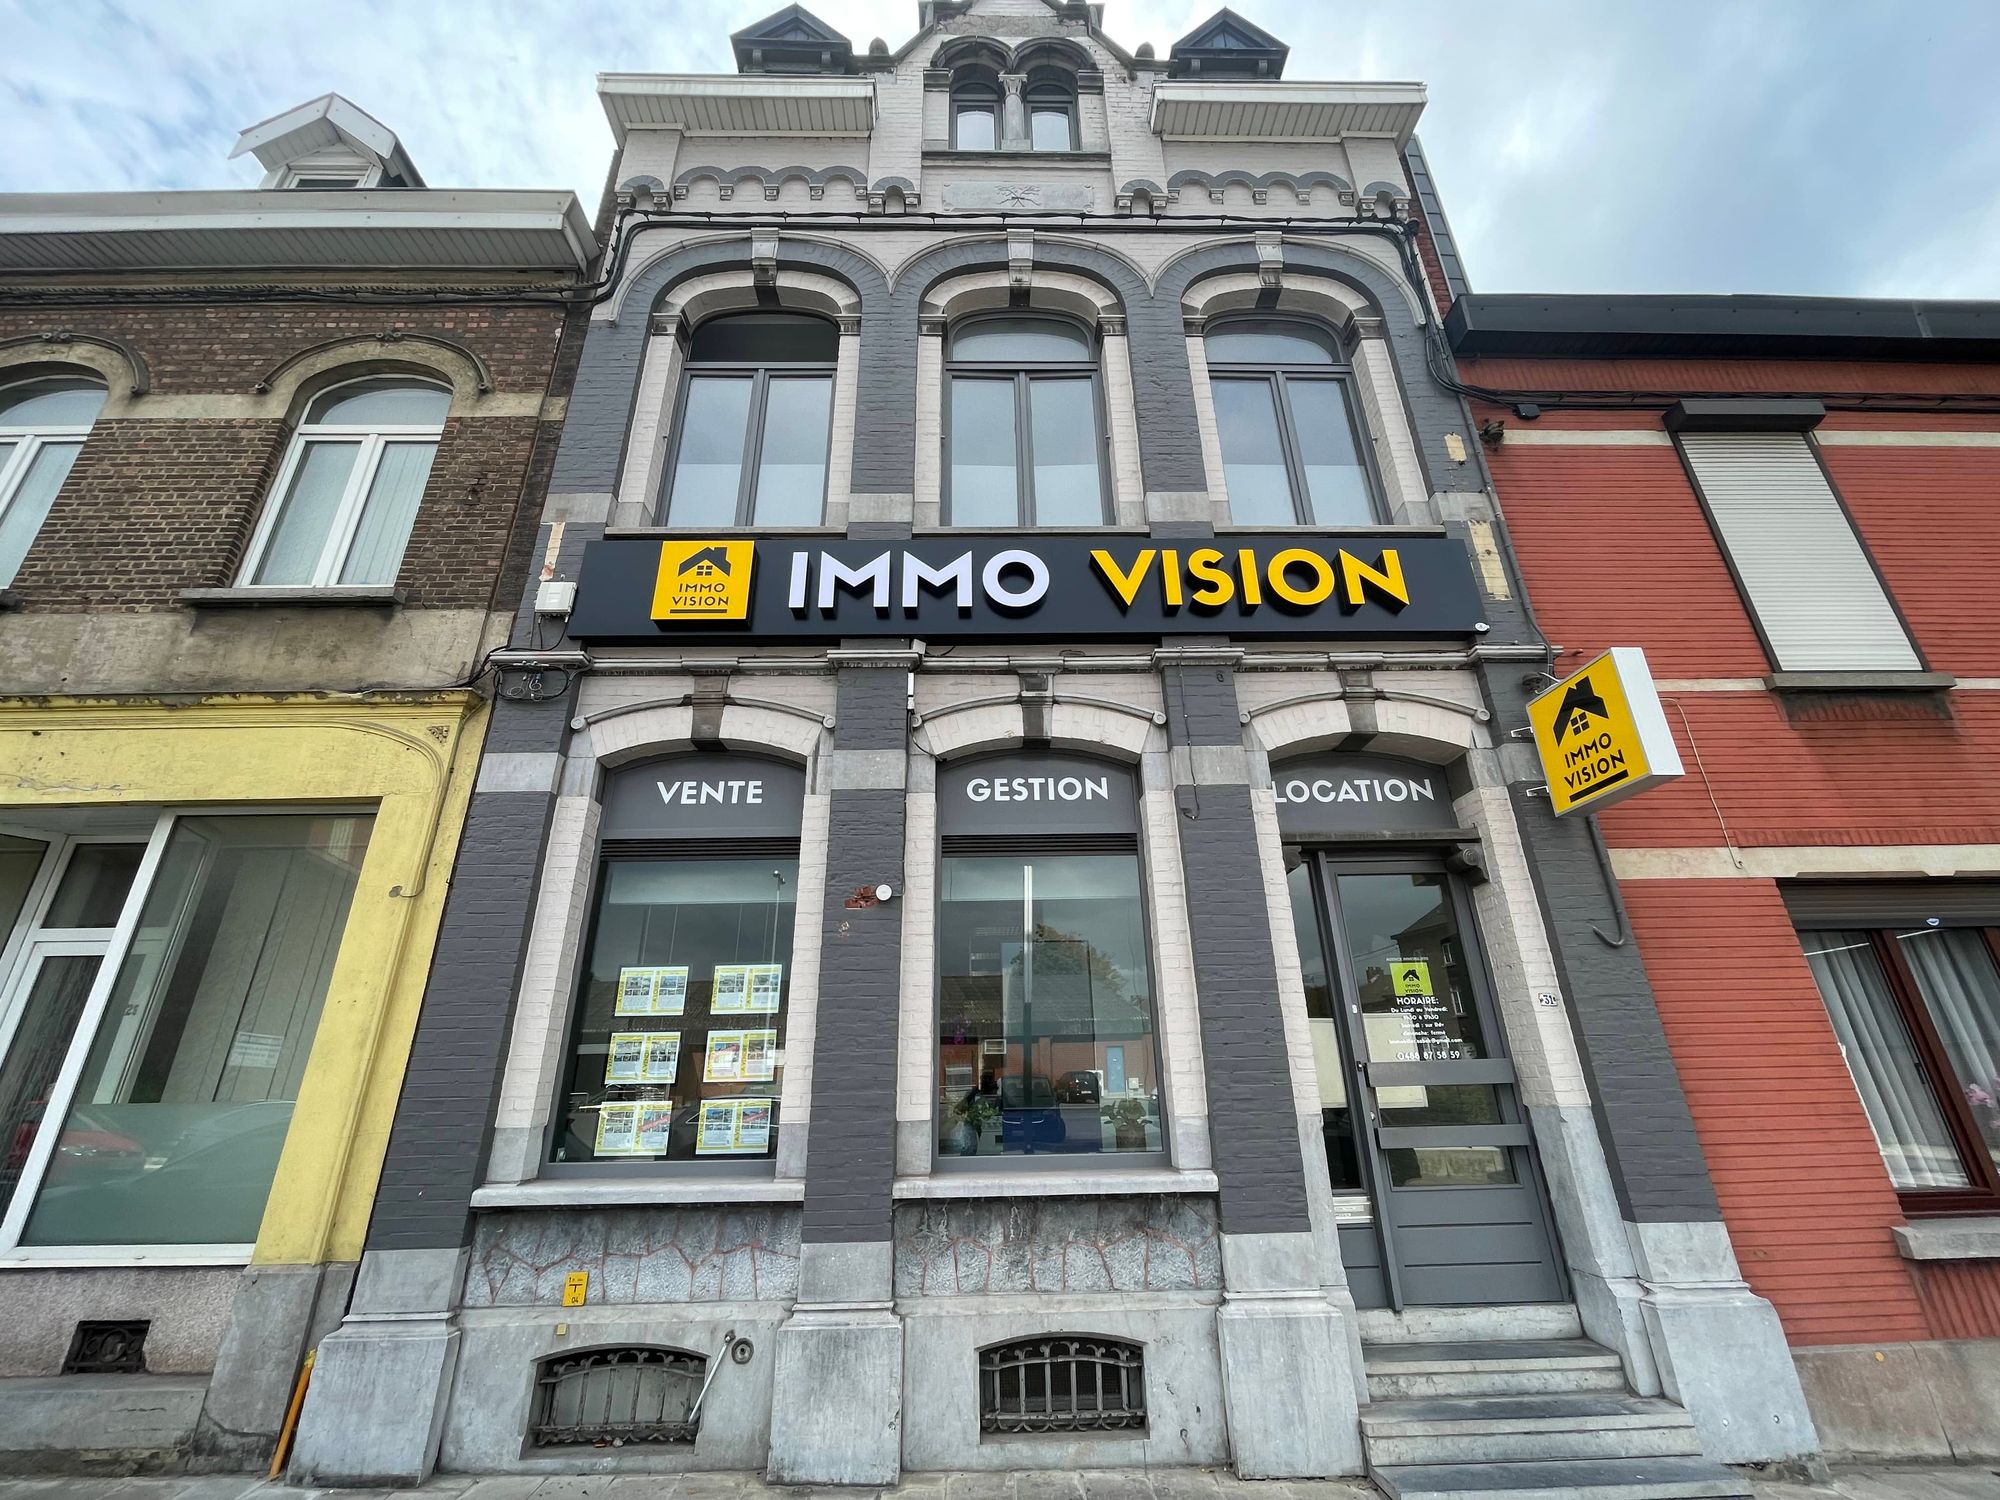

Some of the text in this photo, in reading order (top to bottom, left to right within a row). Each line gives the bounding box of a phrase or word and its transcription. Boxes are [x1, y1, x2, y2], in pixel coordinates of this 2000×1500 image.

[679, 583, 725, 593] IMMO
[789, 548, 1410, 608] IMMO VISION
[672, 596, 729, 606] VISION
[1564, 732, 1612, 769] IMMO
[1564, 749, 1626, 789] VISION
[656, 780, 763, 805] VENTE
[966, 777, 1109, 802] GESTION
[1271, 779, 1435, 803] LOCATION
[1396, 996, 1440, 1005] HORAIRE:
[1436, 1051, 1447, 1059] 58
[1450, 1050, 1460, 1059] 59
